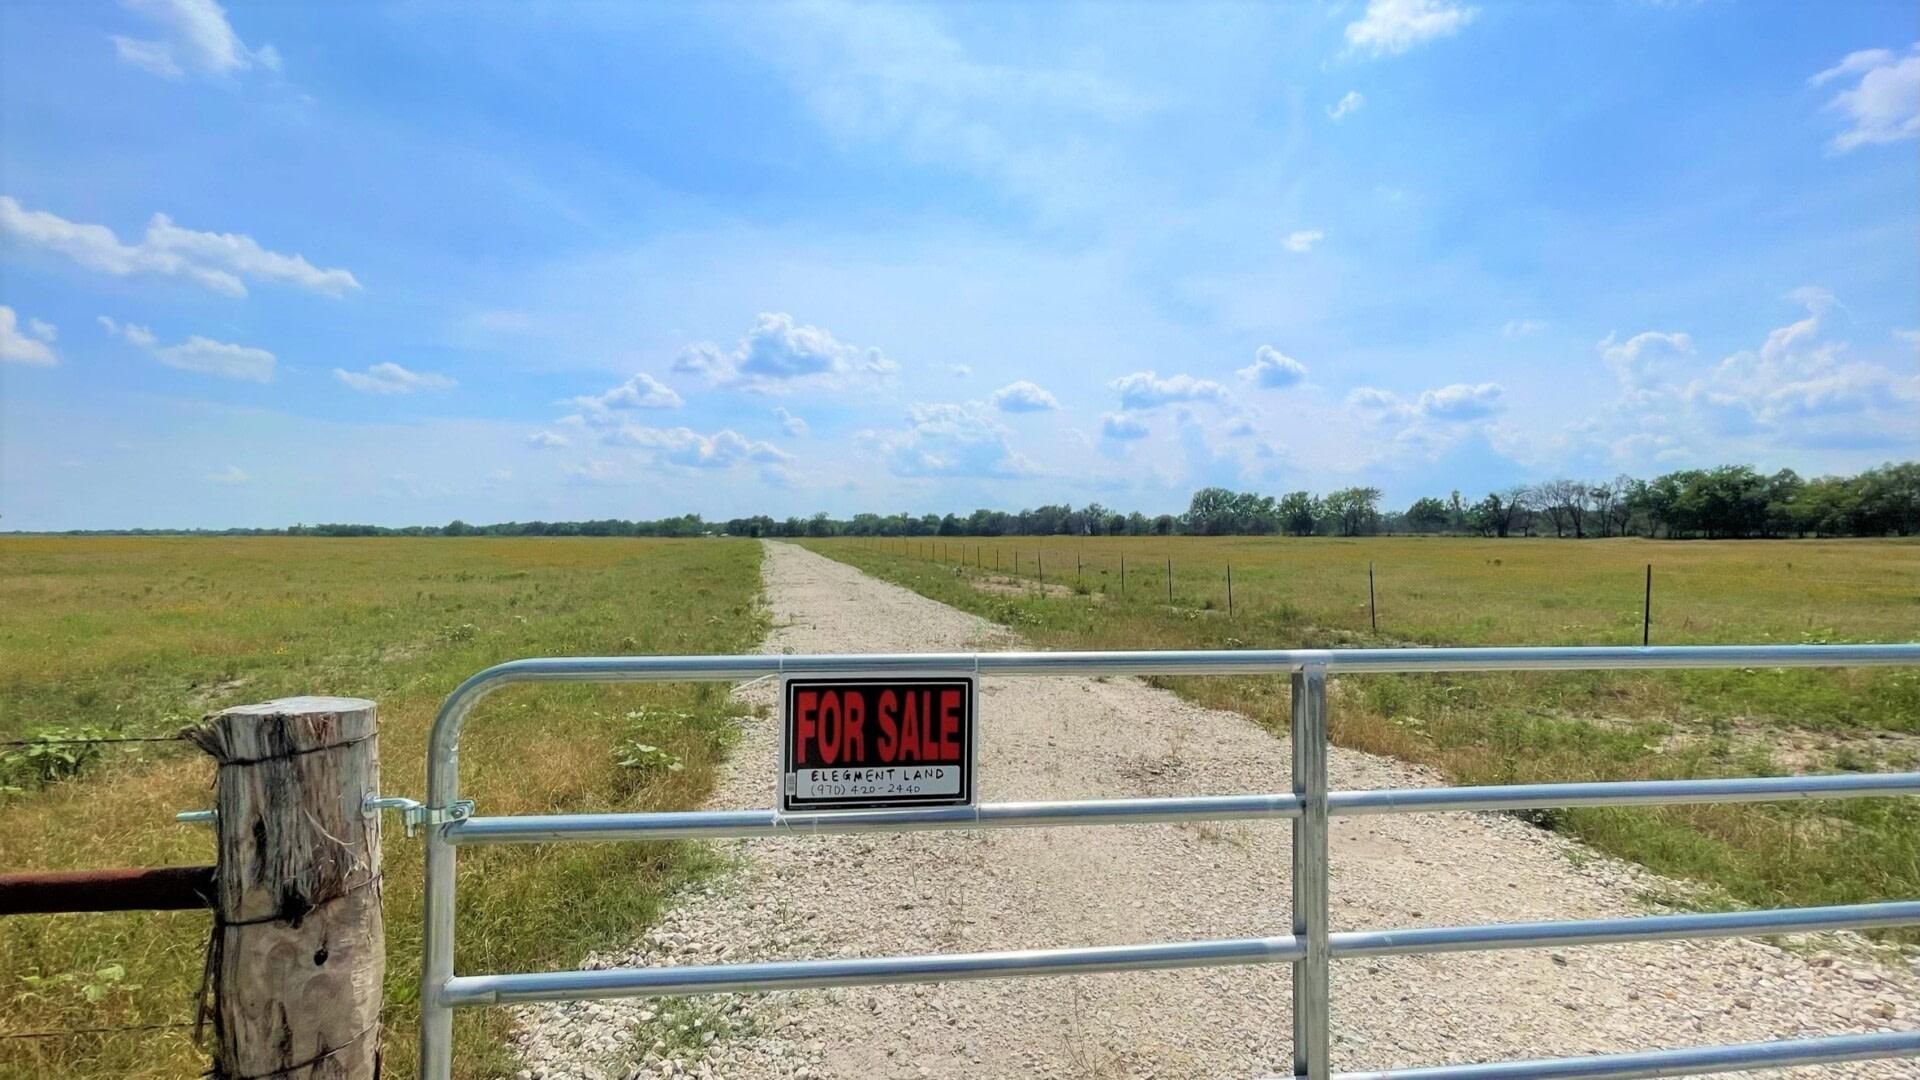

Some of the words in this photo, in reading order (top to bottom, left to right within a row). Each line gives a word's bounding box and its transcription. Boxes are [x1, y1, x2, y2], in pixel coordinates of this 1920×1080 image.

[797, 690, 865, 764] FOR
[878, 689, 961, 762] SALE
[903, 768, 944, 781] LAND
[810, 784, 846, 796] (970)
